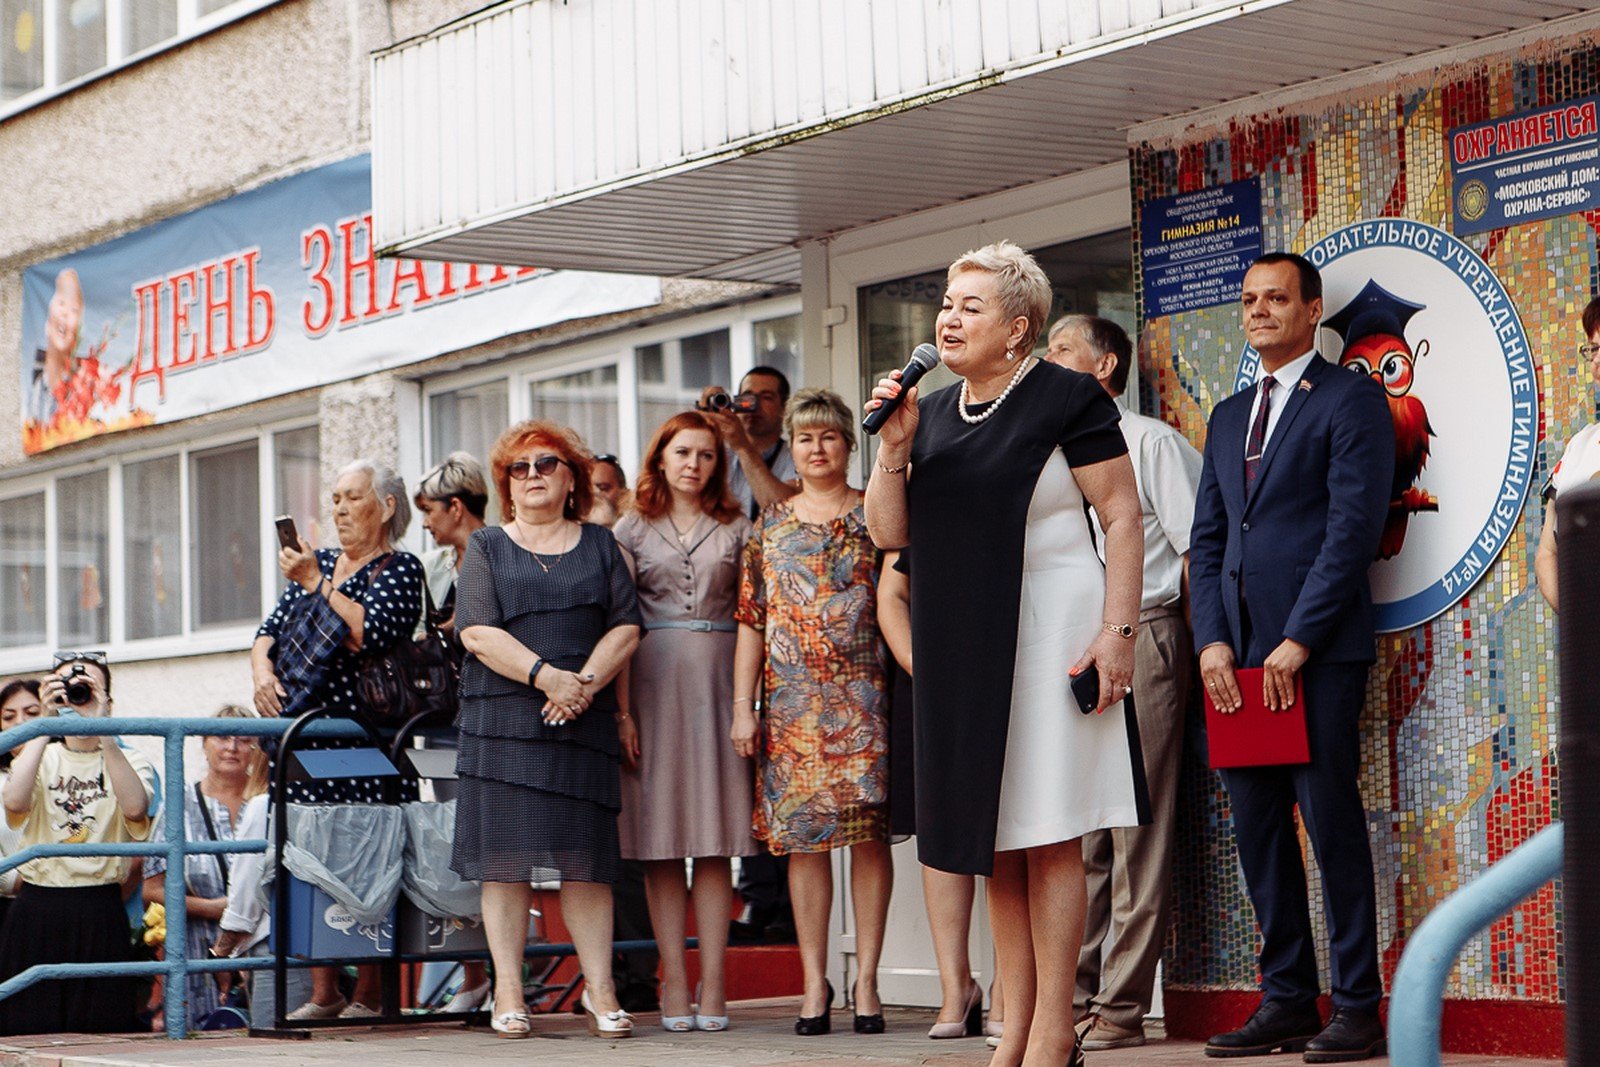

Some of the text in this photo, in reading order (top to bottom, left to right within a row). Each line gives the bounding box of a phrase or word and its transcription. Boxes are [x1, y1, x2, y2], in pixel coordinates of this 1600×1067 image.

[1454, 101, 1598, 165] ОХРАНЯЕТСЯ
[1496, 149, 1598, 179] ЧАСТНАЯ ОХРАННАЯ ОРГАНИЗАЦИЯ
[1495, 171, 1568, 202] «МОСКОВСКИЙ
[1572, 167, 1600, 188] ДОМ:
[1504, 187, 1591, 218] ОХРАНА-СЕРВИС»
[1162, 220, 1215, 242] ГИМНАЗИЯ
[1239, 226, 1259, 237] ОКРУГА
[129, 249, 275, 408] ДЕНЬ
[1441, 240, 1530, 395] УЧРЕЖДЕНИЕ
[1477, 401, 1531, 556] ГИМНАЗИЯ
[1442, 551, 1482, 595] №14
